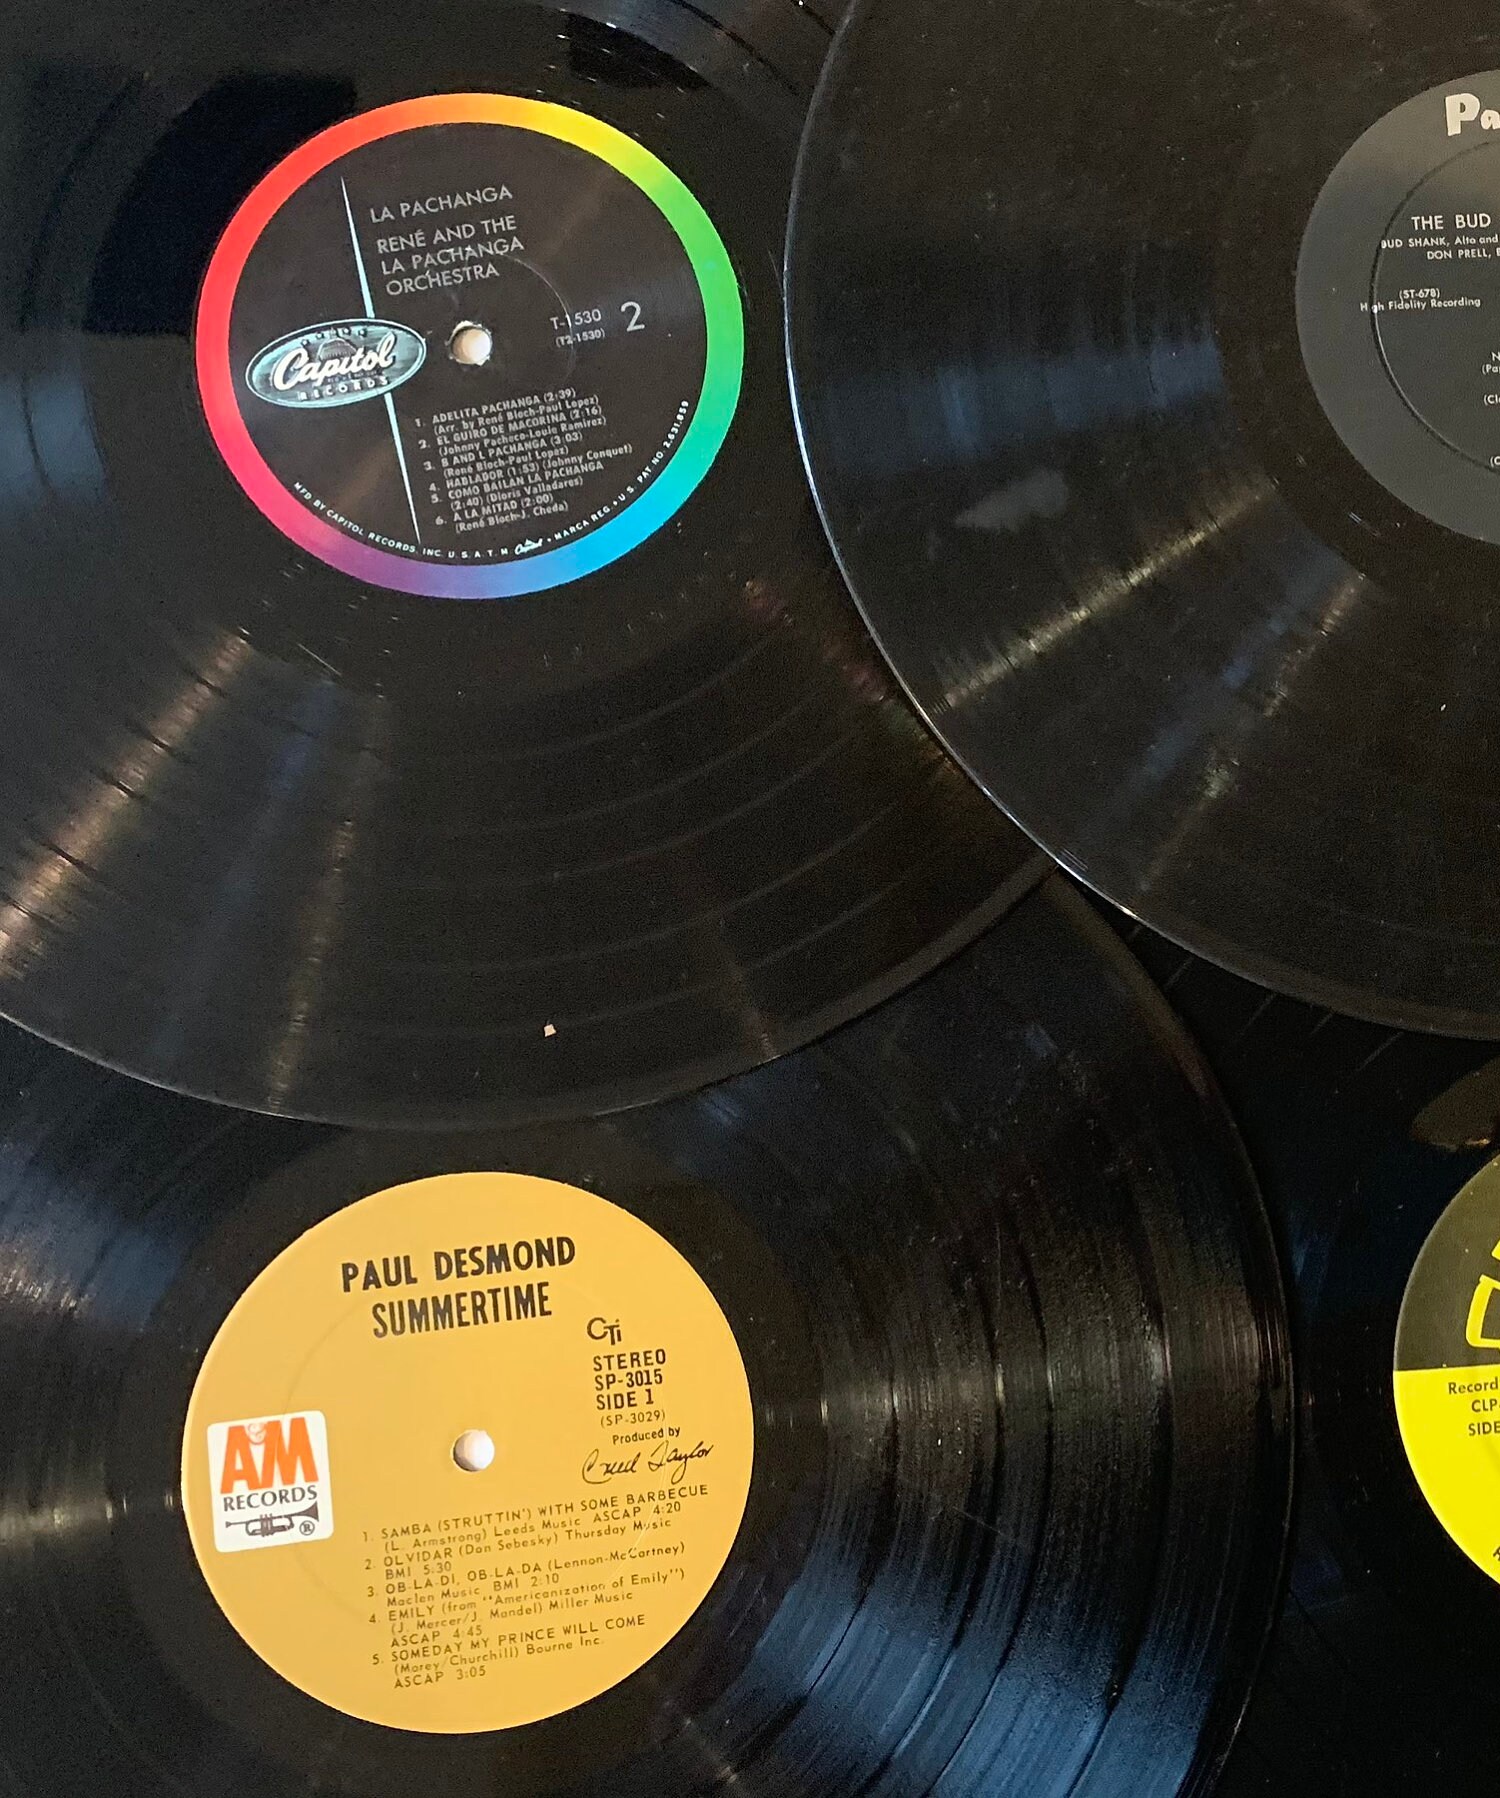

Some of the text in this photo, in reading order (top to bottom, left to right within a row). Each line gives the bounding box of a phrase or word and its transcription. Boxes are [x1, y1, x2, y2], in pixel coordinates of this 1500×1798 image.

[370, 184, 513, 223] LA PACHANGA
[1411, 215, 1444, 231] THE
[1455, 213, 1491, 229] BUD
[377, 215, 517, 254] RENÉ AND THE
[1381, 239, 1403, 249] BUD
[1408, 236, 1450, 248] SHANK,
[1454, 235, 1476, 246] Alto
[1479, 234, 1499, 244] and
[381, 236, 525, 276] LA PACHANGA
[1427, 249, 1452, 260] DON
[1458, 248, 1492, 260] PRELL,
[386, 262, 500, 296] ORCHESTRA
[550, 308, 602, 330] T-1530
[620, 301, 646, 332] 2
[555, 328, 606, 348] (T2-1530)
[273, 332, 397, 391] Capitol
[298, 377, 390, 401] RECORDS
[432, 408, 479, 424] ADELITA
[482, 395, 540, 418] PACHANGA
[554, 519, 590, 541] MARCA
[341, 1236, 575, 1292] PAUL DESMOND
[372, 1281, 552, 1338] SUMMERTIME
[593, 1348, 666, 1372] STEREO
[595, 1369, 663, 1392] SP-3015
[1448, 1375, 1499, 1395] Record
[596, 1389, 654, 1410] SIDE 1
[600, 1409, 665, 1429] (SP-3029)
[612, 1426, 680, 1445] Produced by
[223, 1485, 318, 1512] RECORDS
[381, 1522, 431, 1539] SAMBA
[537, 1502, 574, 1517] WITH
[580, 1496, 618, 1512] SOME
[626, 1485, 708, 1505] BARBECUE
[391, 1642, 463, 1663] SOMEDAY
[470, 1638, 489, 1650] MY
[498, 1627, 555, 1646] PRINCE
[563, 1621, 598, 1636] WILL
[605, 1614, 645, 1629] COME
